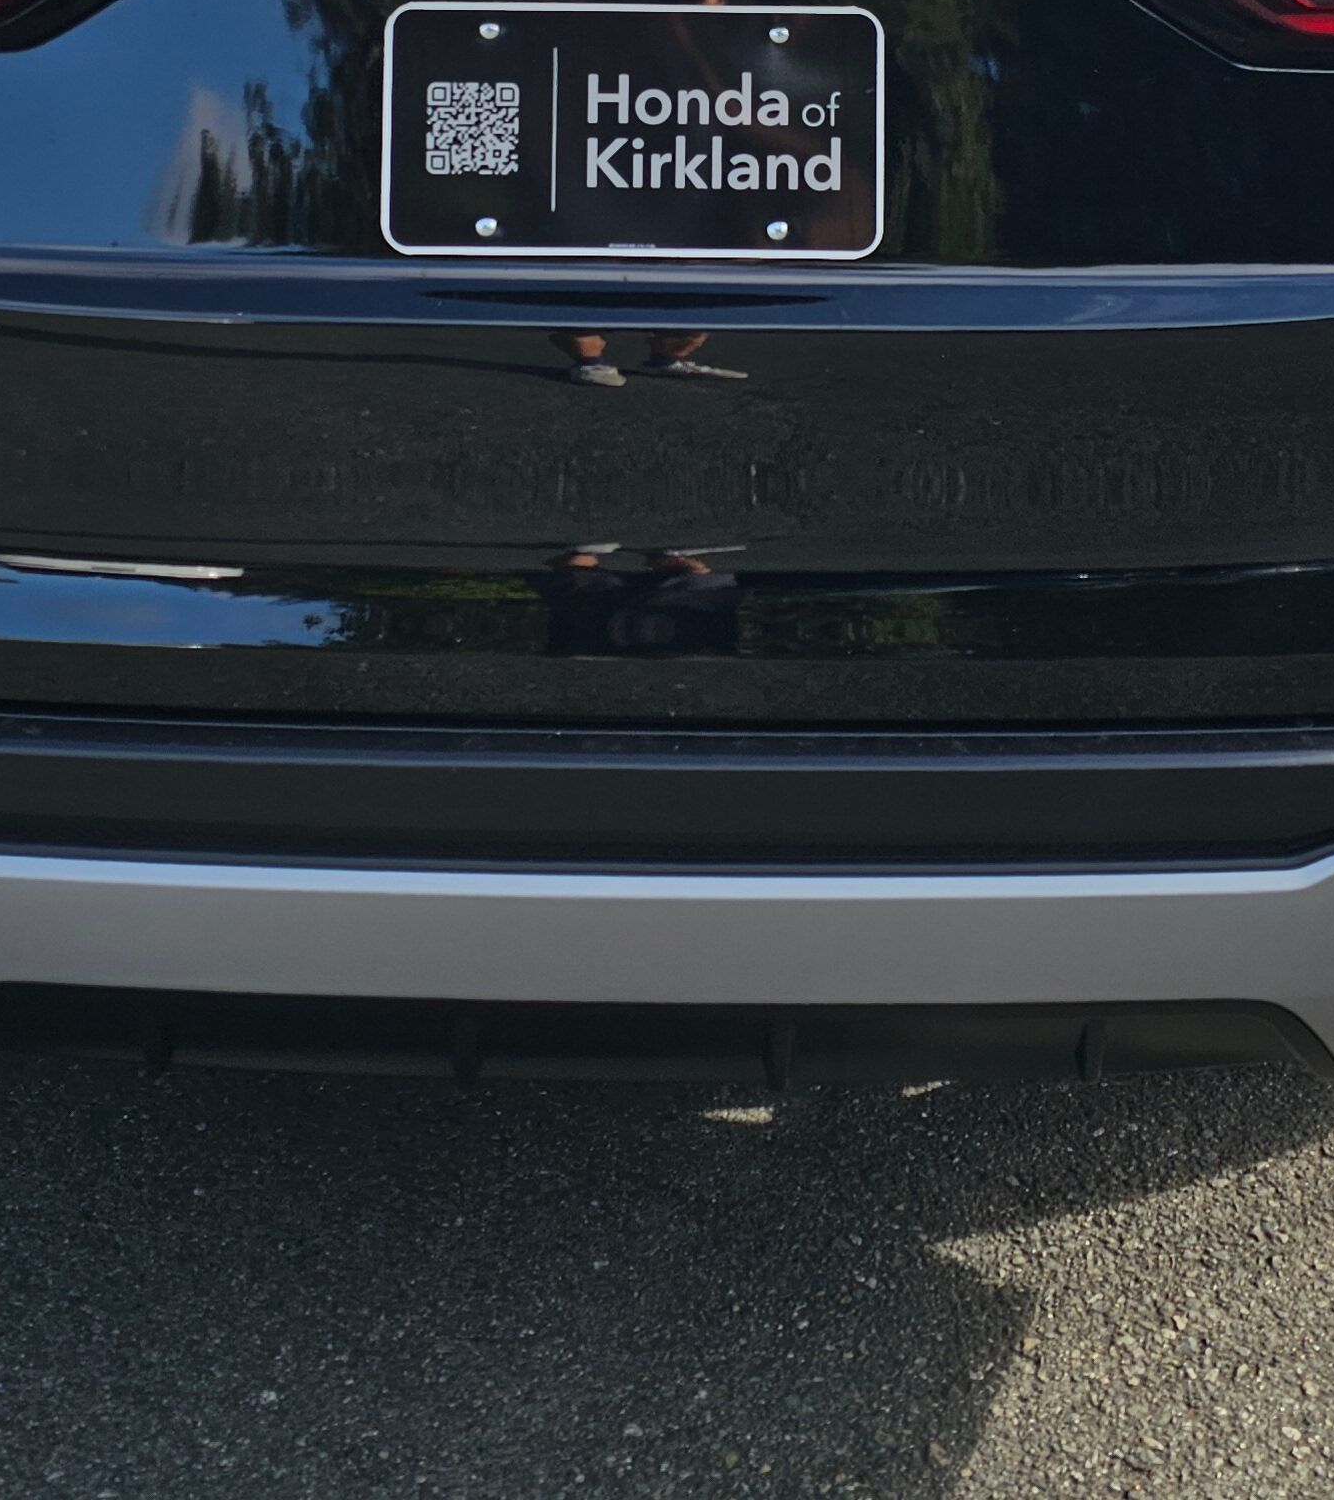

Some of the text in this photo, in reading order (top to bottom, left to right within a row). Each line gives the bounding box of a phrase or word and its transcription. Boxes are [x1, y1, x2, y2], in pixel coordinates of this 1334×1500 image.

[586, 71, 841, 128] Honda of
[586, 135, 842, 191] Kirkland
